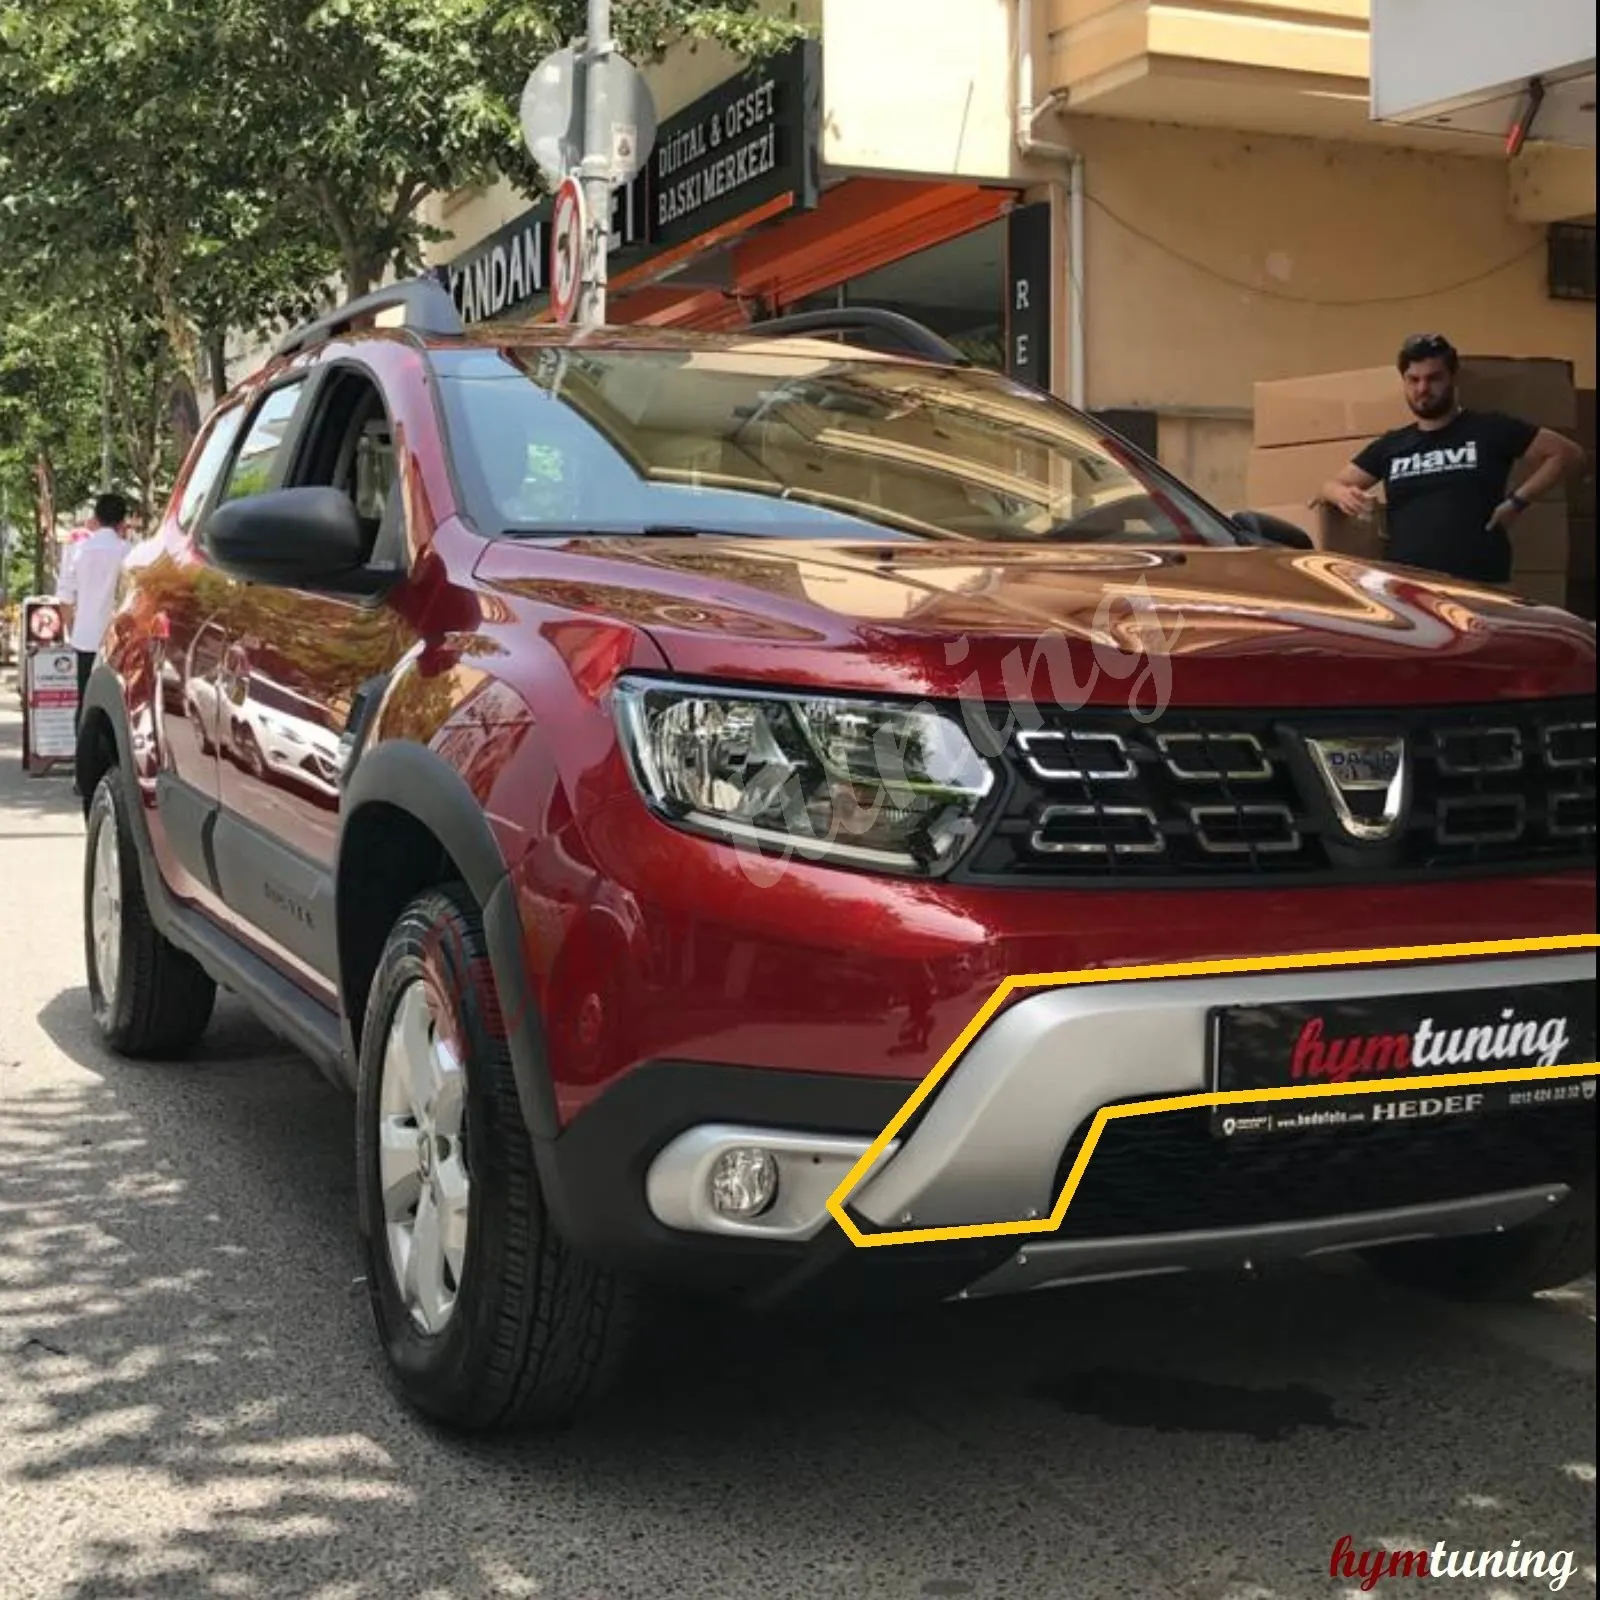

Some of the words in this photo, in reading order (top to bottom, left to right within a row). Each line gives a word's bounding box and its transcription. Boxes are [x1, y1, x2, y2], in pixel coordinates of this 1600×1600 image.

[710, 113, 721, 147] &
[725, 79, 775, 138] OFSET
[658, 171, 702, 226] BASKI
[702, 123, 775, 203] MERKEZİ
[1391, 440, 1476, 474] mavi
[1288, 1007, 1570, 1083] hymtuning
[1372, 1093, 1485, 1121] HEDEF
